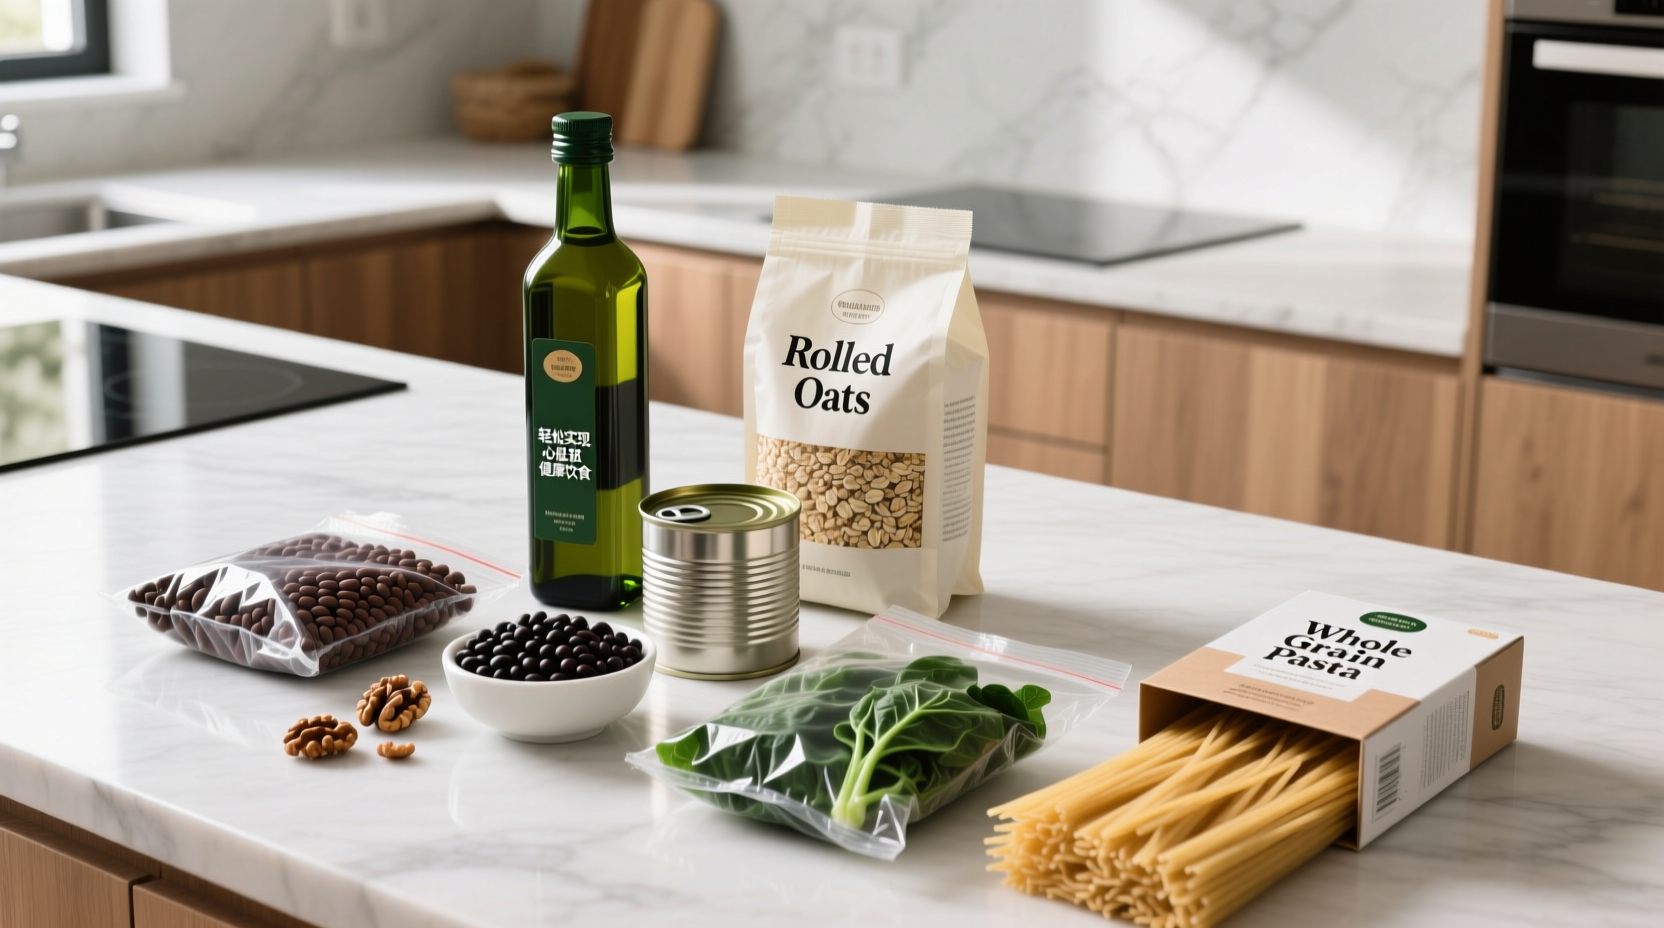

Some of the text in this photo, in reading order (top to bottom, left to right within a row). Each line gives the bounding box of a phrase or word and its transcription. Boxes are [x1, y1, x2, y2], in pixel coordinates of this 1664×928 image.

[781, 334, 895, 376] Rolled
[794, 376, 871, 415] Oats
[1283, 634, 1387, 671] Grain
[1307, 619, 1412, 659] Whole
[1262, 646, 1362, 680] Pasta
